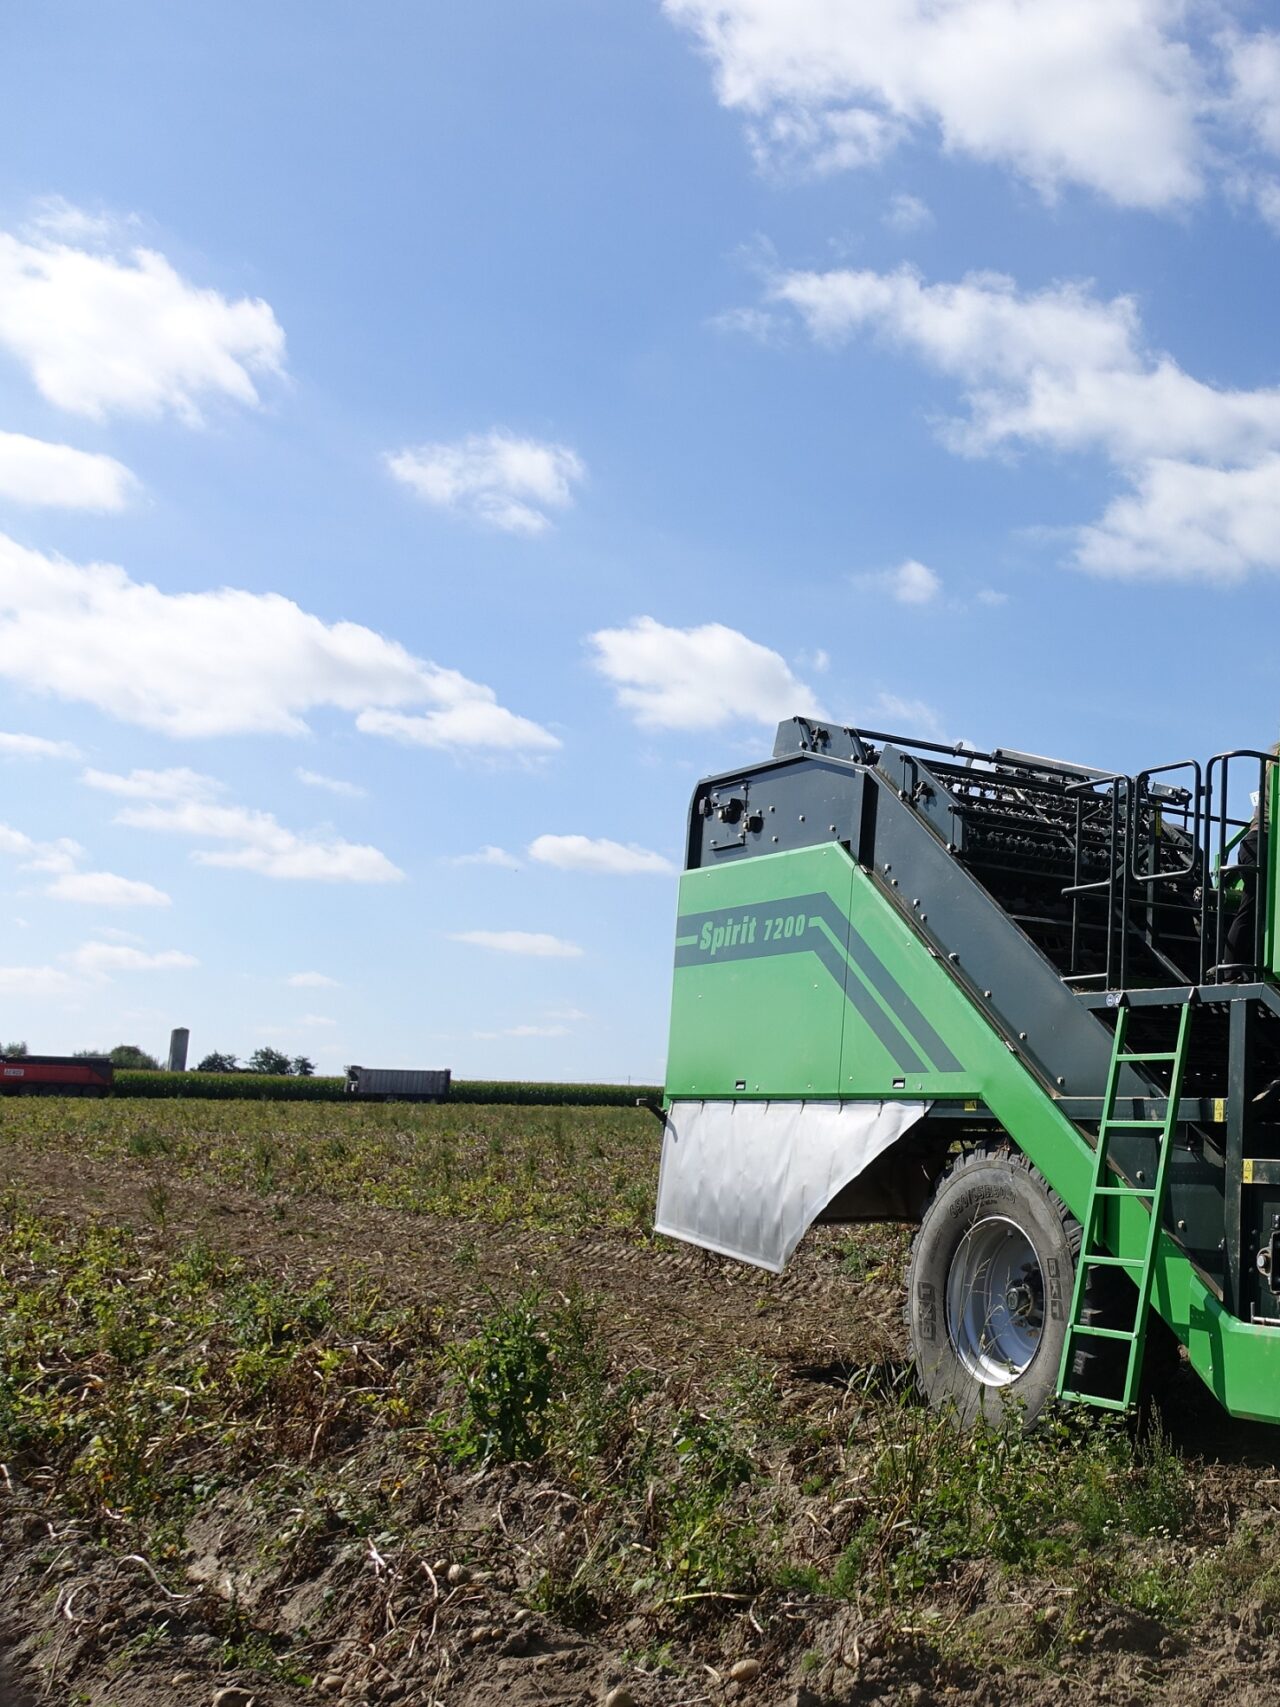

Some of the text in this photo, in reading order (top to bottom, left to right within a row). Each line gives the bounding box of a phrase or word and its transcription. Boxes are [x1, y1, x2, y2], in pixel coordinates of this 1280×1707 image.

[700, 914, 806, 956] Spirit 7200
[918, 1281, 936, 1341] BKT
[1047, 1258, 1064, 1321] BKT
